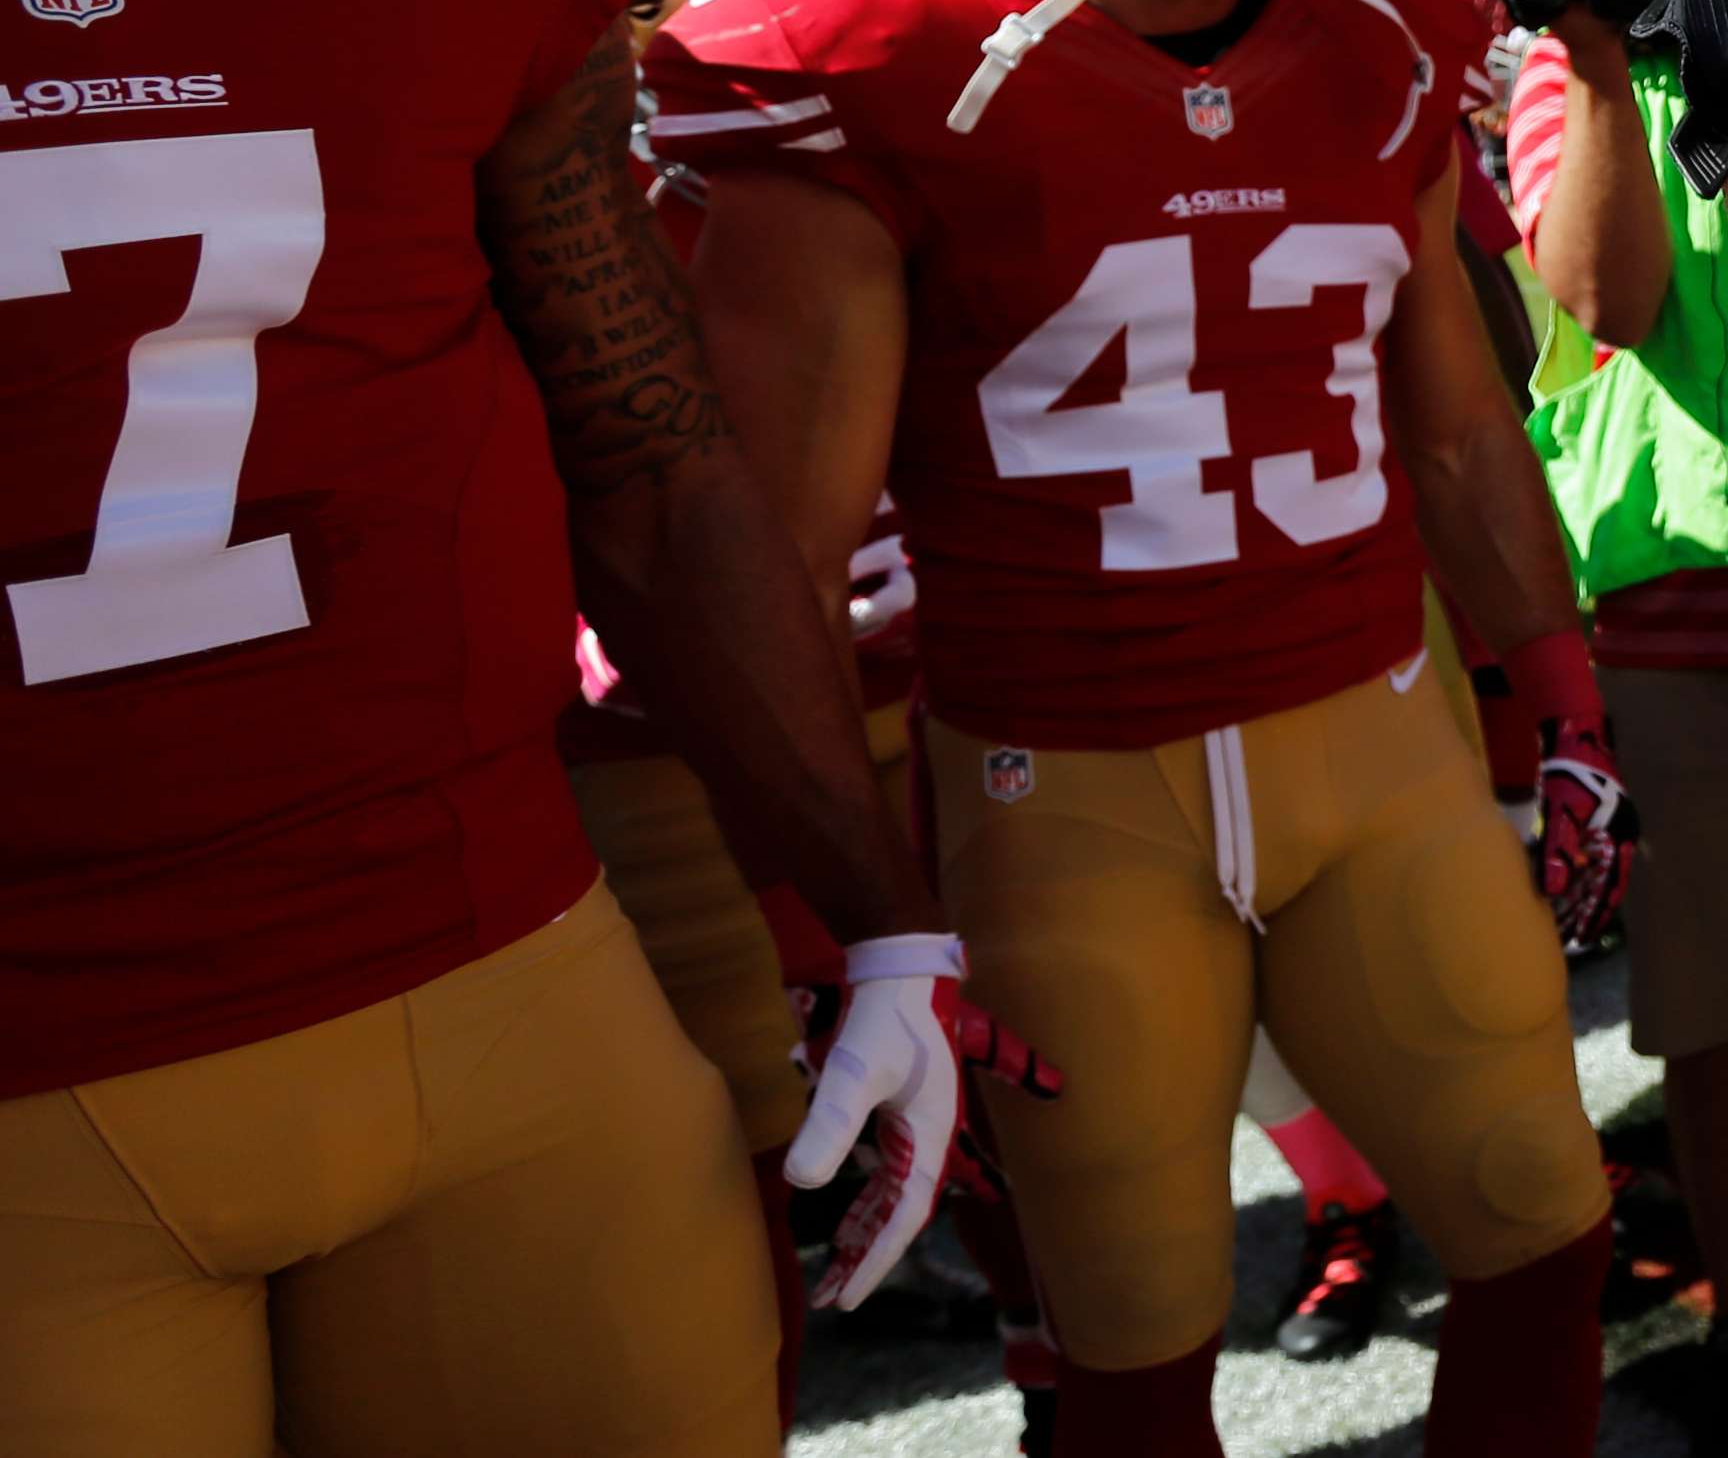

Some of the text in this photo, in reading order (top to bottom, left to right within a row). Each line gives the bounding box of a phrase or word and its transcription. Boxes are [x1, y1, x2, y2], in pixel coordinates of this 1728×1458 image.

[1162, 188, 1286, 218] 49ERS
[0, 128, 326, 686] 7
[977, 223, 1412, 571] 43
